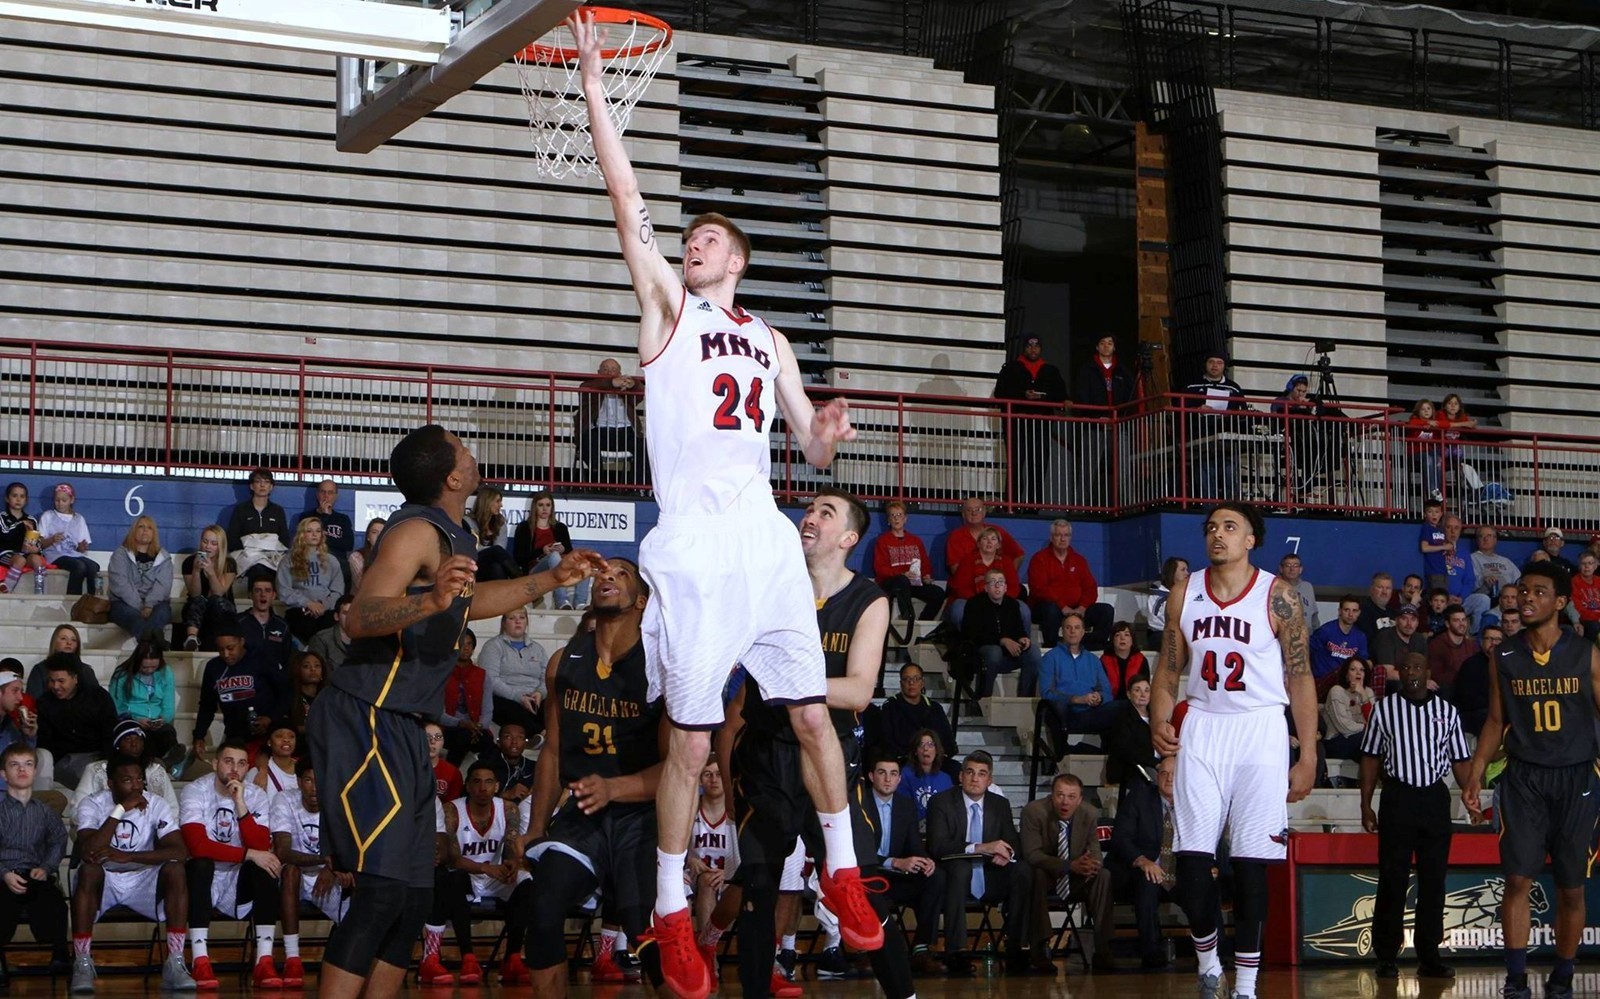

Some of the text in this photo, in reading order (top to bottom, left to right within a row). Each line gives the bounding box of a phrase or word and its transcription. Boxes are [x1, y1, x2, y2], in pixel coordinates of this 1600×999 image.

[700, 332, 771, 371] MNU
[712, 373, 765, 433] 24
[125, 484, 145, 517] 6
[557, 511, 628, 530] TUDENTS
[1285, 536, 1301, 555] 7
[1192, 615, 1252, 645] MNU
[216, 675, 254, 691] MNU
[1201, 650, 1247, 691] 42
[1511, 677, 1580, 696] GRACELAND
[1532, 700, 1562, 732] 10
[582, 722, 618, 756] 31
[462, 839, 500, 856] MNU
